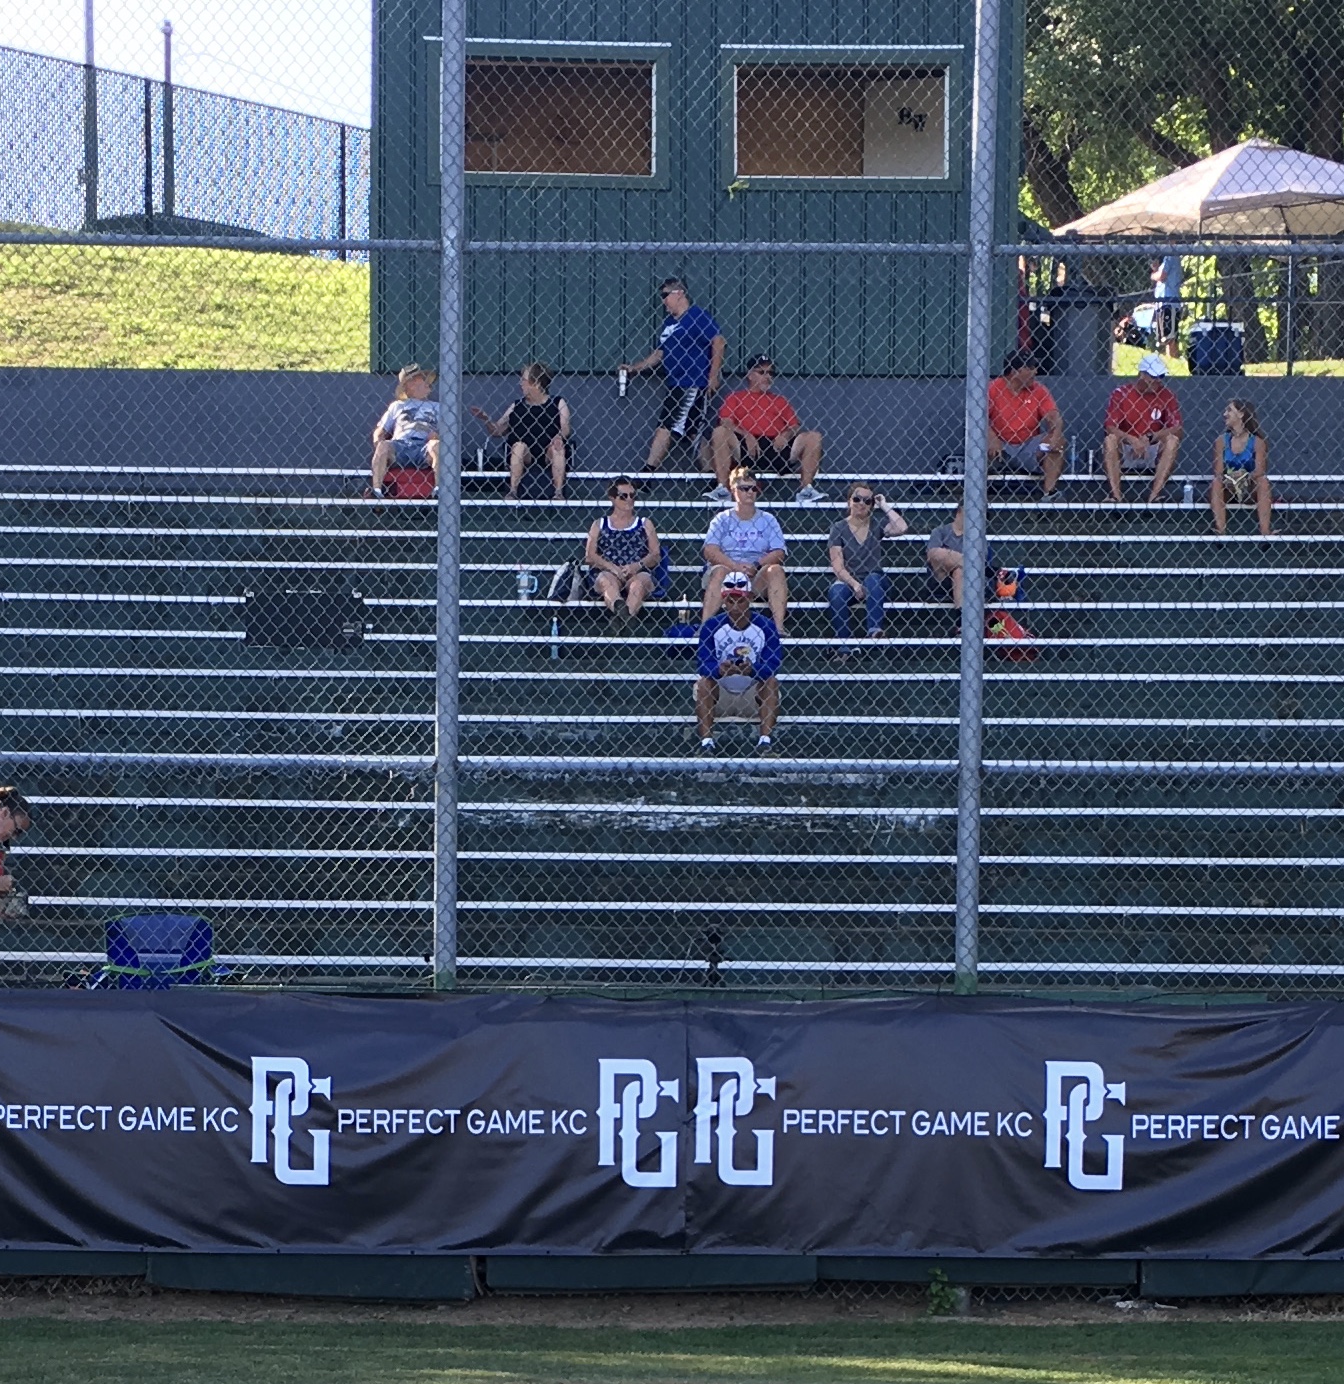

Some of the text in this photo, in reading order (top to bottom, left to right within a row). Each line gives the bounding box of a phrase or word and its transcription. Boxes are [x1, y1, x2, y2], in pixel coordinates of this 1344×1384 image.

[118, 1105, 196, 1131] GAME
[203, 1107, 239, 1132] KC
[249, 1056, 332, 1186] PG
[337, 1108, 461, 1134] PERFECT
[466, 1109, 545, 1135] GAME
[551, 1109, 587, 1135] KC
[596, 1058, 680, 1188] PG
[692, 1056, 777, 1186] PG
[783, 1109, 907, 1135] PERFECT
[911, 1110, 990, 1136] GAME
[996, 1111, 1033, 1137] KC
[1043, 1060, 1126, 1191] PG
[1132, 1114, 1256, 1139] PERFECT
[1261, 1114, 1341, 1140] GAME
